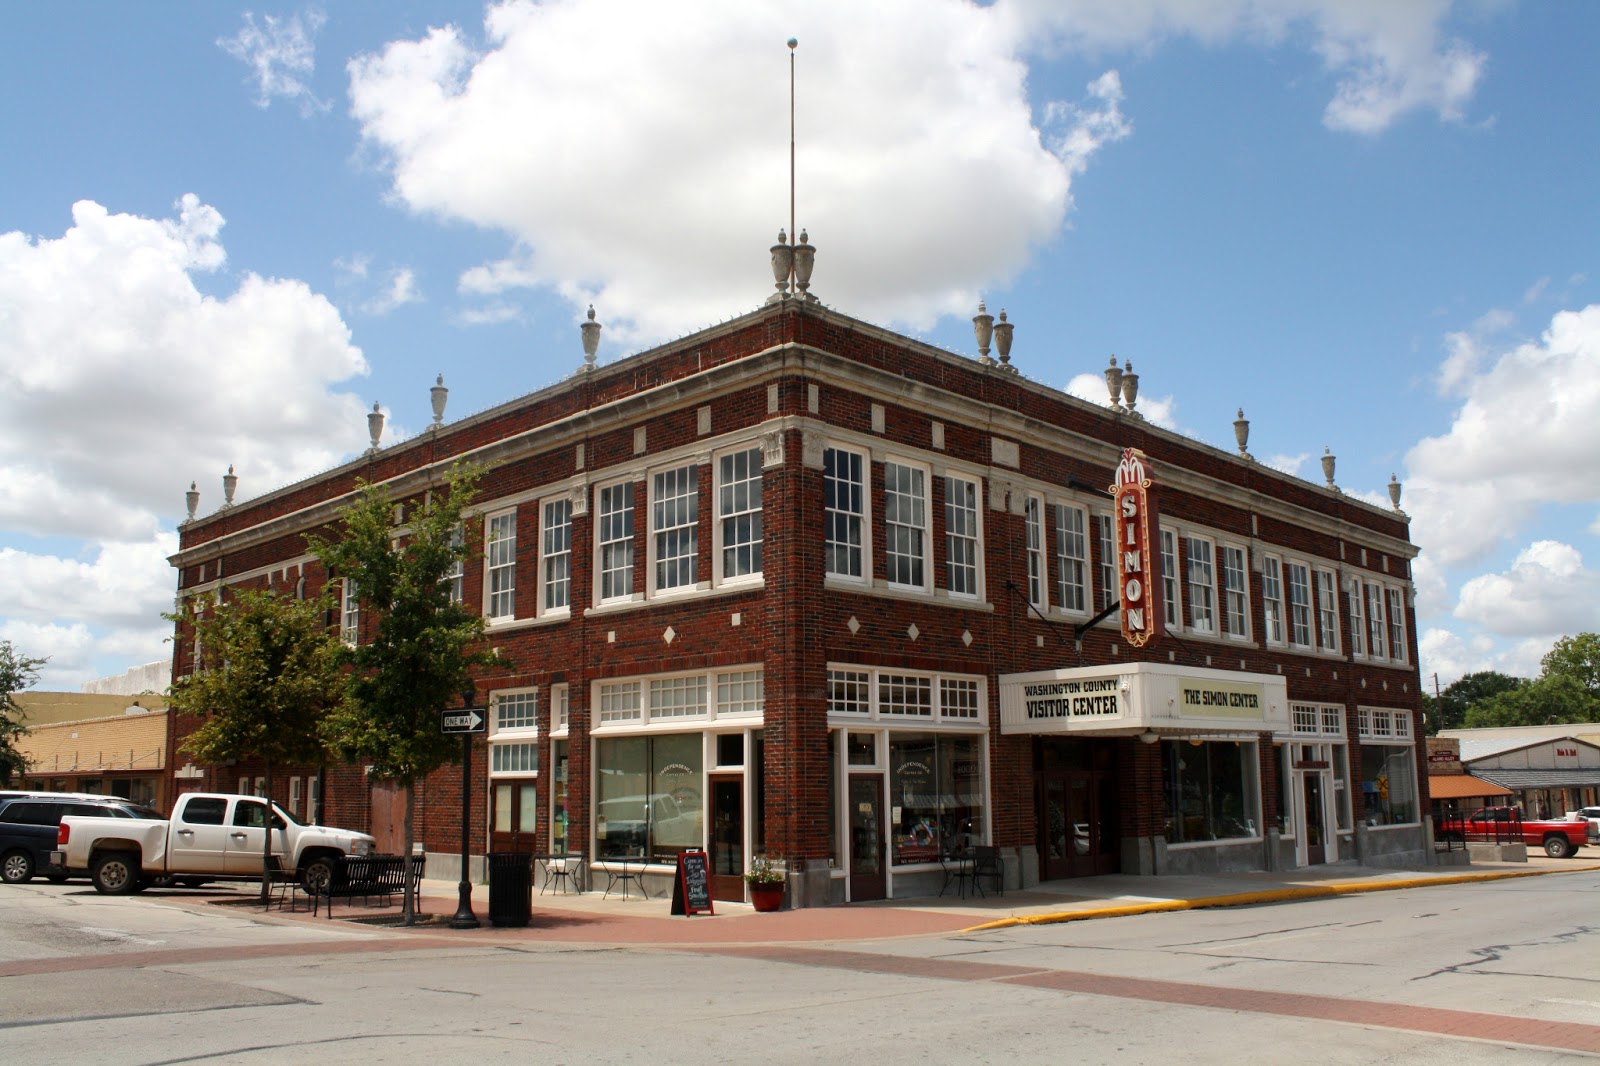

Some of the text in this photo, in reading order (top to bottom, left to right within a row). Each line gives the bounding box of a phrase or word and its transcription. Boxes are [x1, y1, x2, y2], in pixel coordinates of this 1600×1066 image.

[1121, 495, 1145, 631] SIMON
[1024, 680, 1117, 696] WASHINGTON COUNTY
[1026, 696, 1117, 718] VISITOR CENTER
[1184, 689, 1258, 708] THE SIMON CENTER
[446, 716, 473, 726] ONE WAY
[896, 761, 931, 774] INDEPENDENCE
